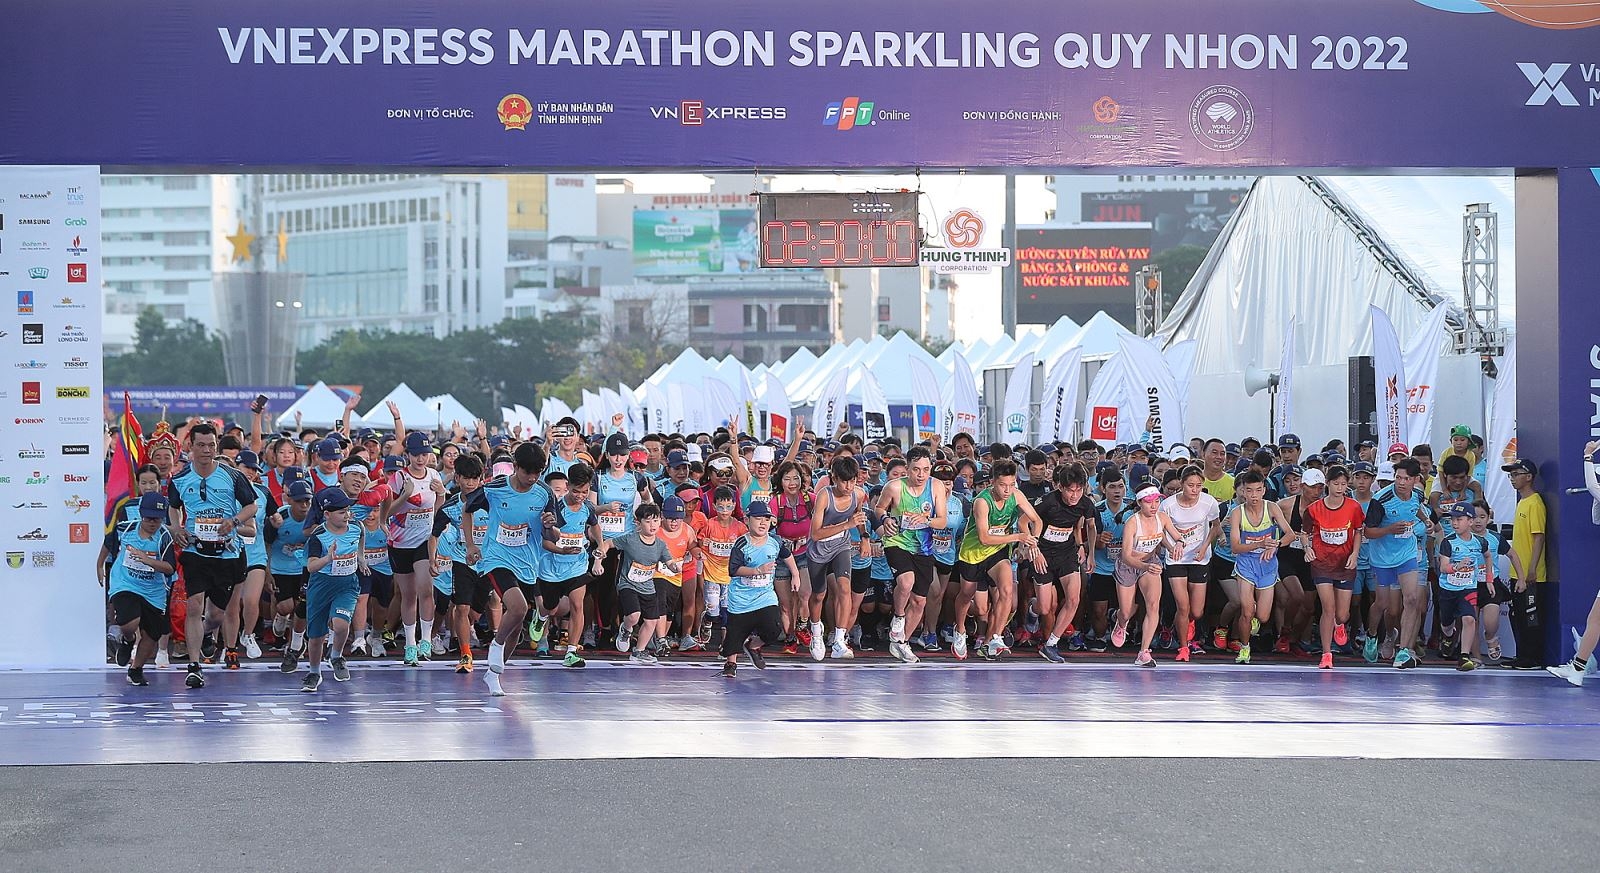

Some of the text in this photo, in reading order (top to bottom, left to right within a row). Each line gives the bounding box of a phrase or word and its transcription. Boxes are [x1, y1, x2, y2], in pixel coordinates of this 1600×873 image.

[218, 28, 1409, 70] VNEXPRESS MARATHON SPARKLING QUY NHON 2022
[1218, 87, 1239, 98] COURSE
[550, 103, 569, 113] BAN
[570, 102, 594, 113] NHÂN
[596, 102, 614, 113] DÂN
[387, 106, 474, 121] ĐƠN VỊ TỔ CHỨC:
[879, 109, 911, 120] Online
[963, 110, 987, 120] ĐƠN
[987, 111, 998, 122] VỊ
[1031, 108, 1062, 121] HÀNH:
[559, 113, 580, 124] BÌNH
[581, 114, 603, 126] ĐỊNH
[65, 217, 87, 226] Grab
[764, 221, 915, 264] 02:30:00
[921, 251, 1007, 262] HUNG THINH
[1057, 246, 1098, 260] XUYÊN
[1127, 249, 1150, 260] TAY
[1119, 262, 1129, 273] &
[57, 390, 88, 398] BONCHA
[958, 412, 976, 424] FPT
[64, 474, 88, 482] Bkav
[600, 516, 623, 525] 59391
[712, 542, 734, 550] 56265
[0, 699, 488, 710] Express
[0, 706, 504, 719] arathon
